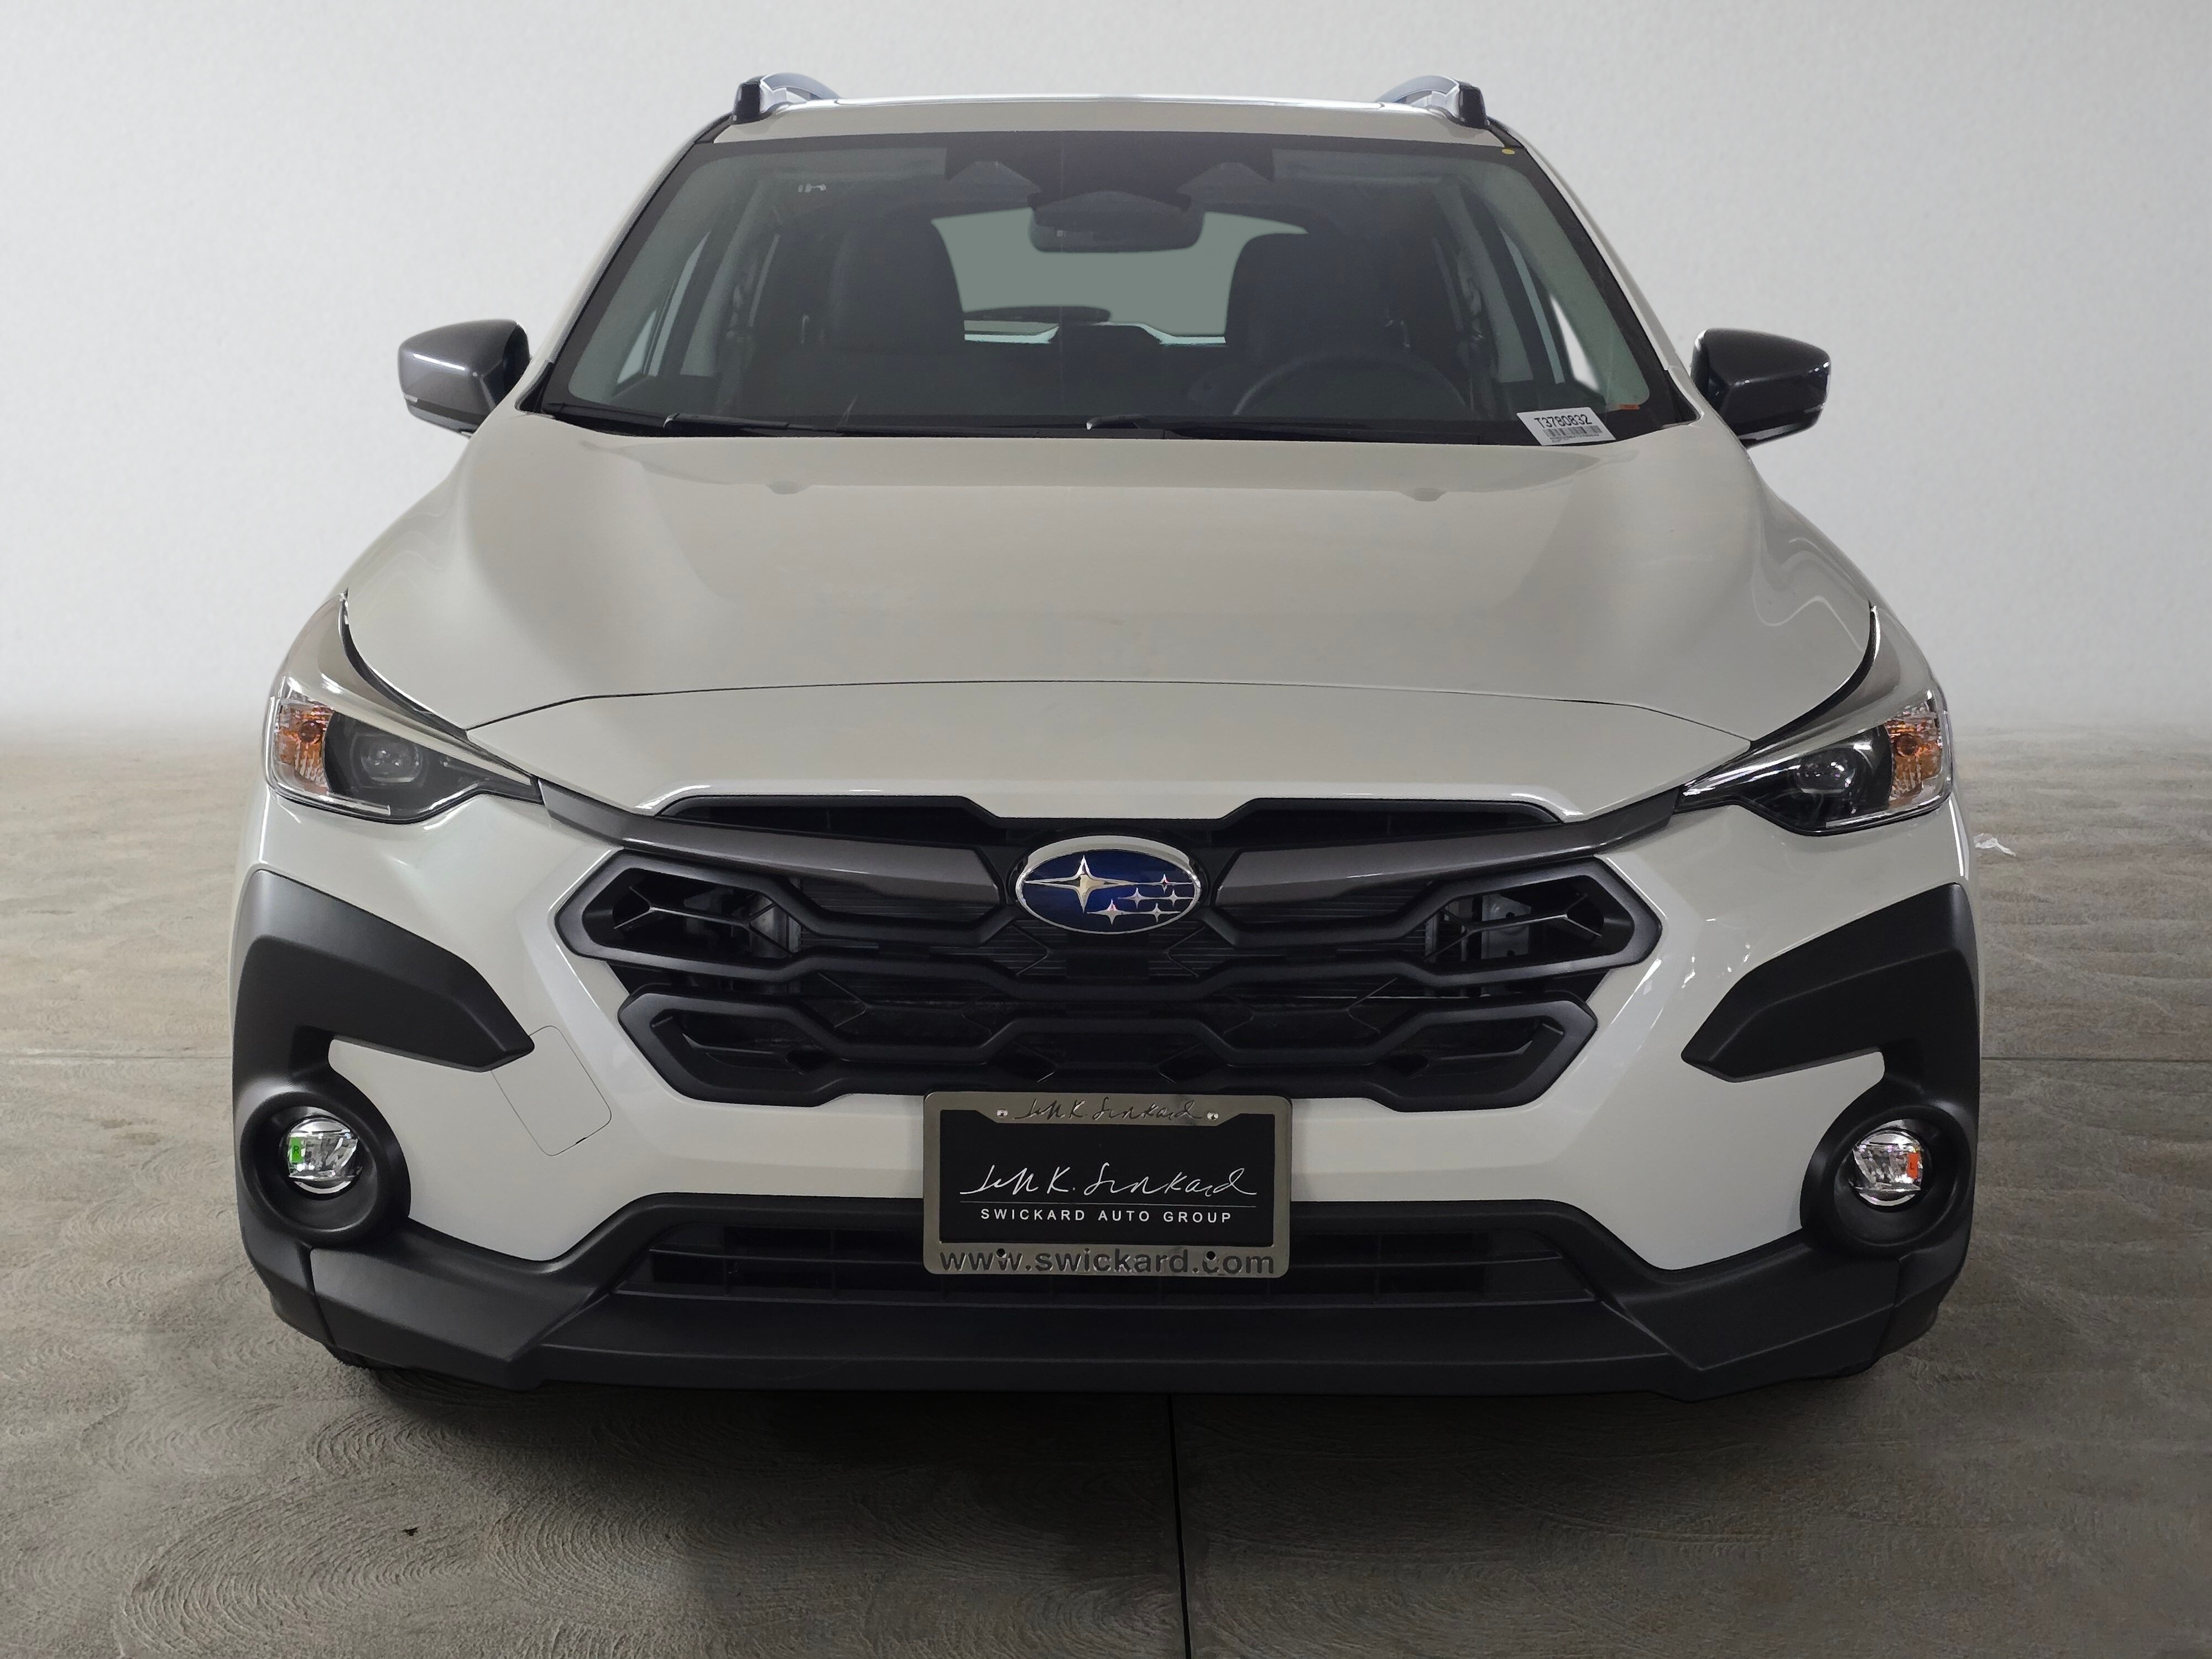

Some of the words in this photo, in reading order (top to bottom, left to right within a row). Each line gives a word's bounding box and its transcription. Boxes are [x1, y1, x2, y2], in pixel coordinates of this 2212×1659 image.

[1534, 414, 1593, 428] T3780832
[980, 1208, 1085, 1221] SWICKARD
[1098, 1210, 1150, 1222] AUTO
[1163, 1211, 1232, 1223] GROUP
[940, 1248, 1274, 1274] www.swickard.com
